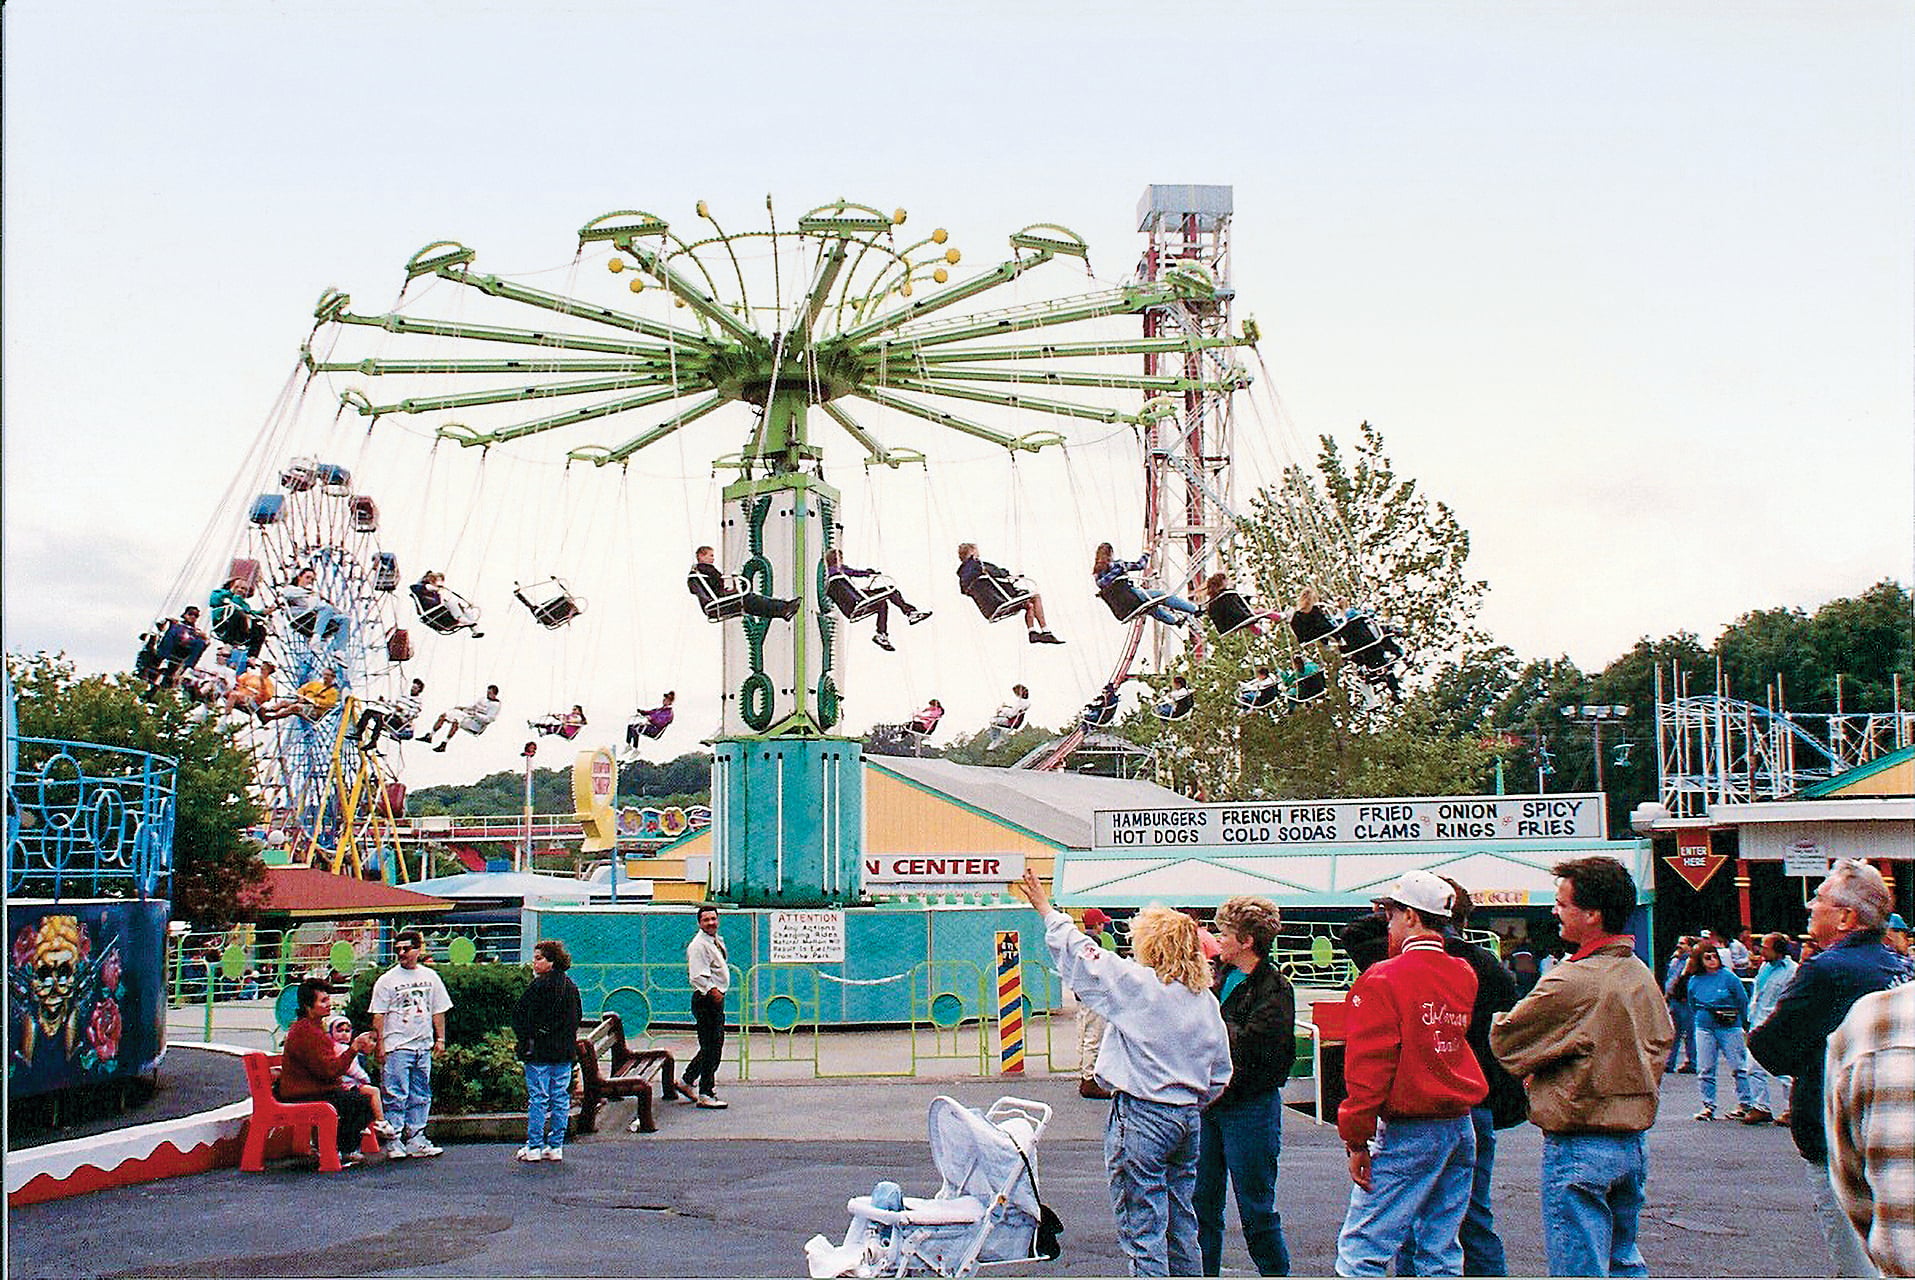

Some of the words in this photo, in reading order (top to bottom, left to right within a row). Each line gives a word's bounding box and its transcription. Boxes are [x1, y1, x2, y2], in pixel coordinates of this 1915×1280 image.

[1221, 809, 1282, 825] FRENCH
[1290, 807, 1337, 823] FRIES
[1359, 805, 1413, 821] FRIED
[1438, 803, 1498, 819] ONION
[1522, 801, 1583, 818] SPICY
[1112, 811, 1207, 828] HAMBURGERS
[1517, 819, 1576, 836] FRIES
[1112, 829, 1147, 844] HOT
[1153, 829, 1200, 844] DOGS
[1221, 827, 1270, 843] COLD
[1277, 825, 1338, 841] SODAS
[1353, 822, 1421, 839] CLAMS
[1435, 821, 1496, 838] RINGS
[1680, 846, 1707, 856] ENTER
[892, 859, 1001, 875] CENTER
[1683, 857, 1707, 867] HERE
[778, 913, 838, 923] ATTENTION
